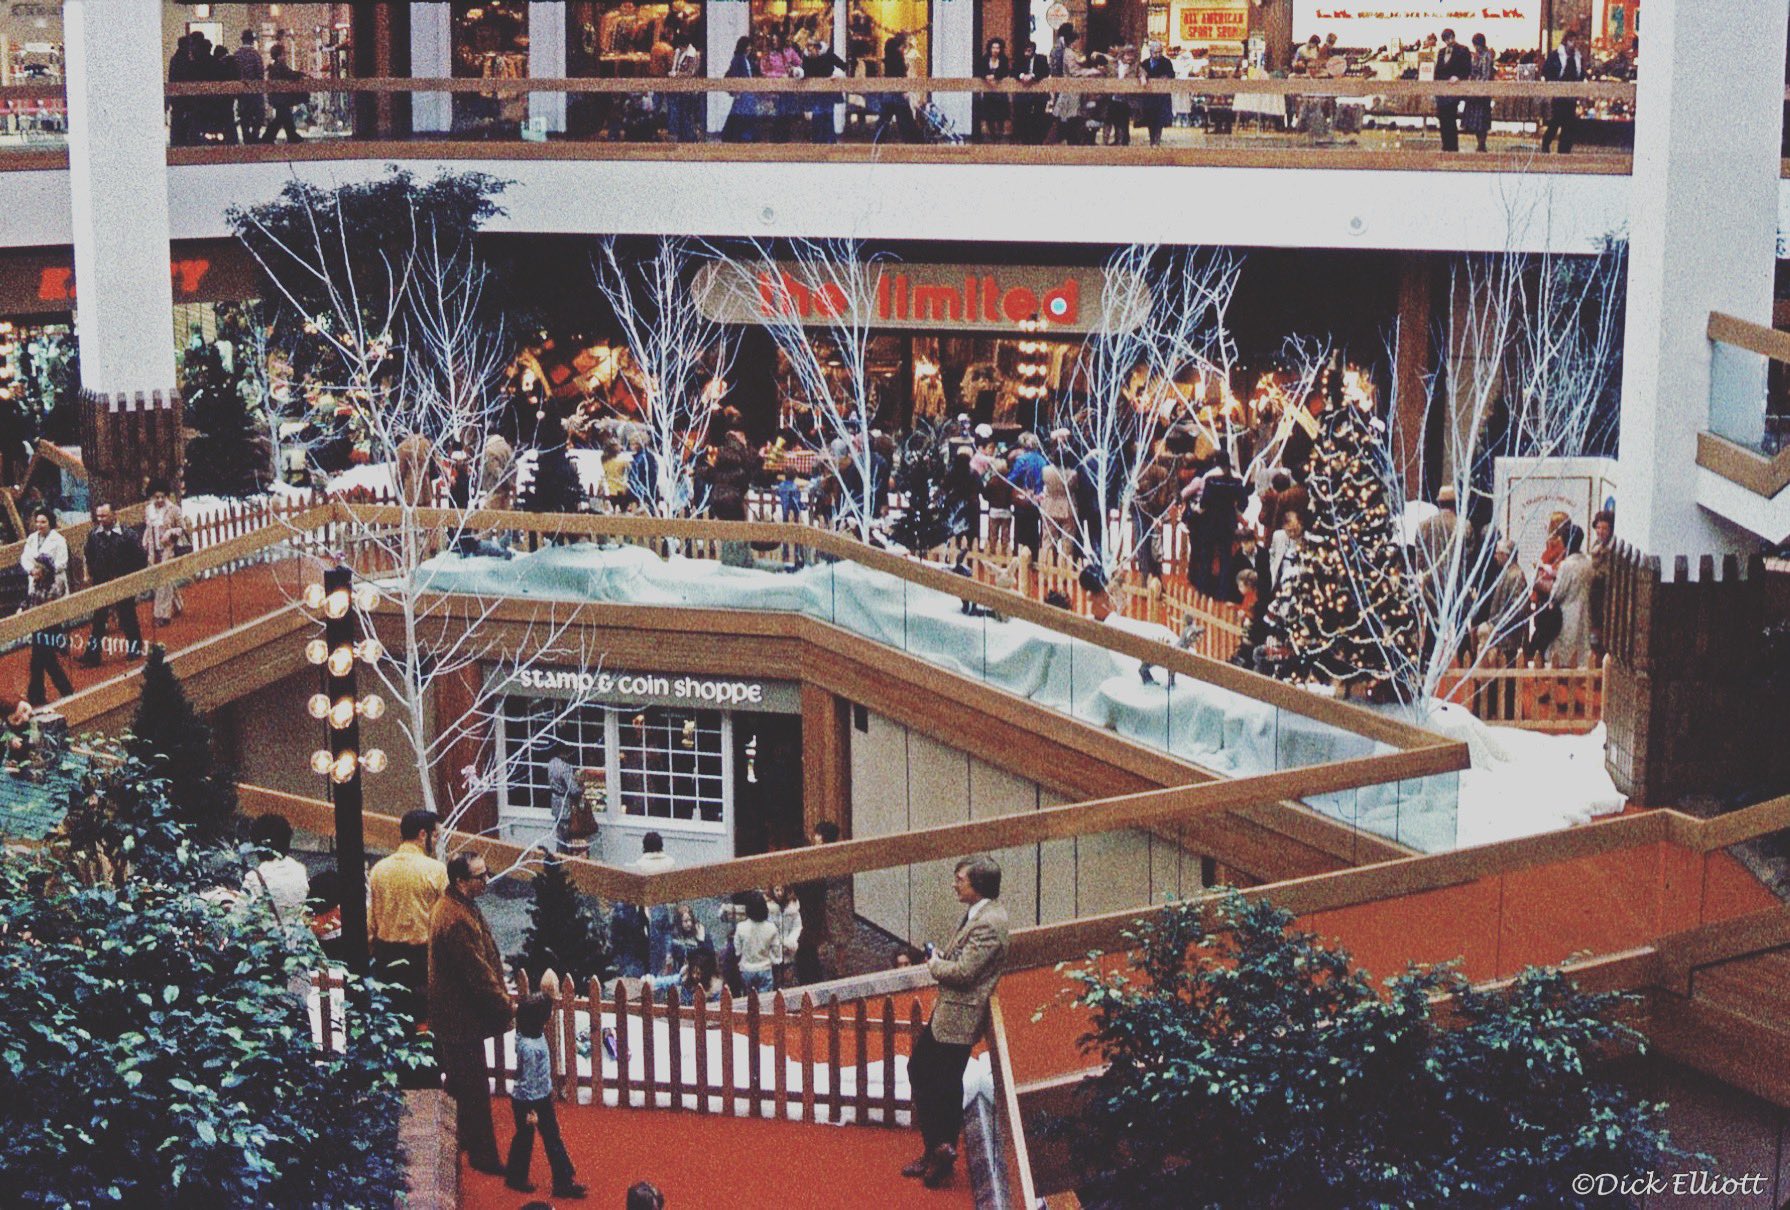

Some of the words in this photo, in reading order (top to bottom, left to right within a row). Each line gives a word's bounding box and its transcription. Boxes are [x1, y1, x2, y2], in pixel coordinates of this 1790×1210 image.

[1201, 12, 1244, 24] AMERICAN
[1188, 26, 1213, 37] SPORT
[758, 271, 850, 318] the
[876, 272, 1078, 325] limited
[520, 668, 594, 698] stamp
[599, 674, 613, 693] &
[617, 674, 669, 696] coin
[674, 676, 763, 704] shoppe
